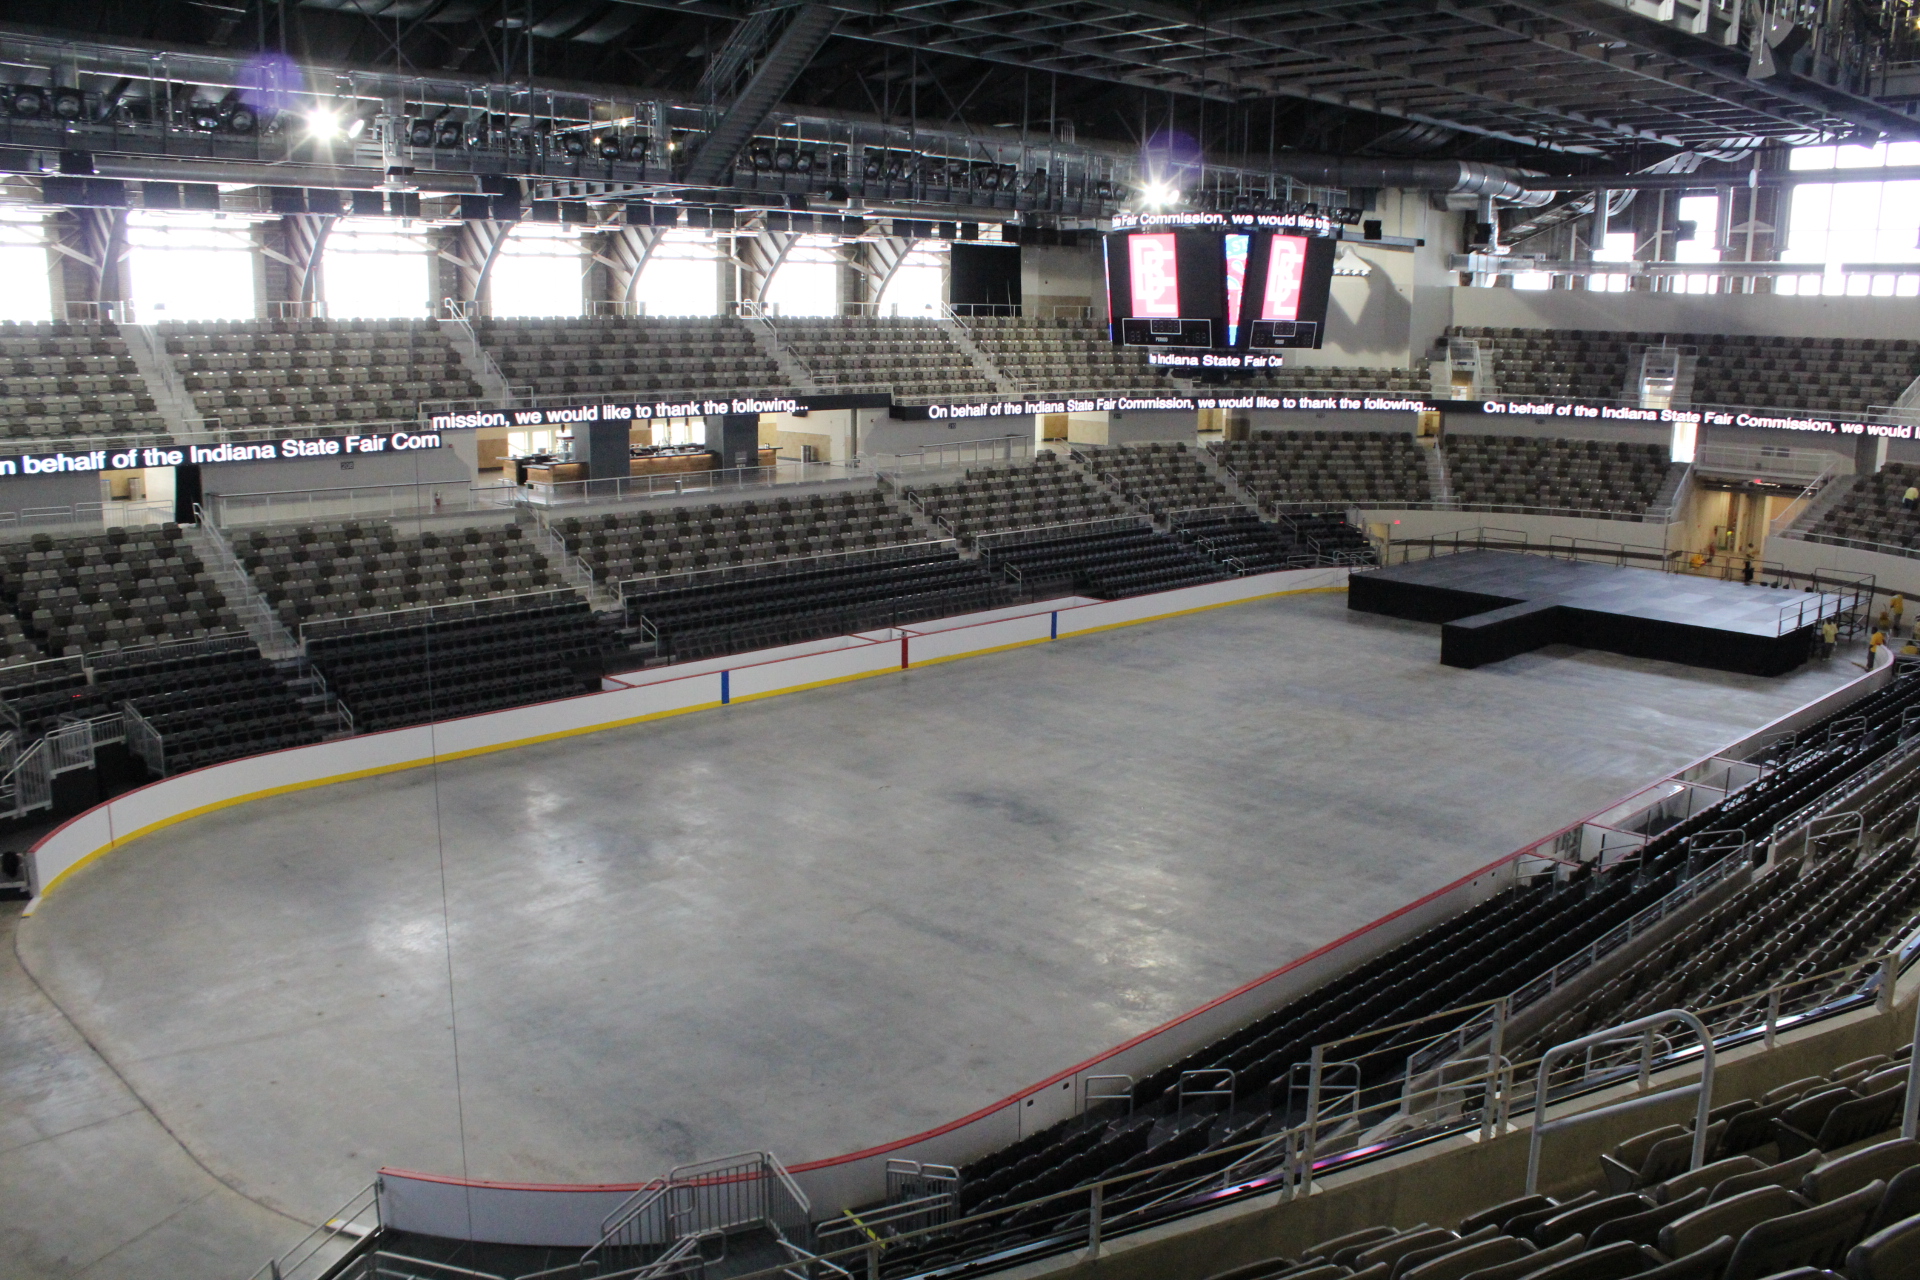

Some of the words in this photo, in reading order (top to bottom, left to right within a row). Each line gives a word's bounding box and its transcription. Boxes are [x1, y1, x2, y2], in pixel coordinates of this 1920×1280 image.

[1122, 214, 1139, 226] Fair
[1140, 212, 1227, 225] Commission,
[1231, 214, 1253, 224] we
[1257, 213, 1296, 226] would
[1298, 215, 1314, 228] like
[1315, 218, 1322, 229] to
[1158, 354, 1199, 365] Indiana
[1203, 355, 1240, 366] State
[1244, 355, 1267, 367] Fair
[432, 411, 510, 429] mission,
[515, 412, 542, 425] we
[546, 405, 598, 423] would
[603, 403, 632, 420] like
[635, 403, 651, 419] to
[655, 400, 700, 417] thank
[704, 398, 729, 415] the
[732, 397, 809, 413] following...
[929, 405, 948, 419] On
[951, 402, 988, 417] behalf
[990, 402, 1003, 415] of
[1004, 402, 1022, 415] the
[1025, 400, 1064, 414] Indiana
[1067, 399, 1094, 412] State
[1097, 398, 1116, 410] Fair
[1118, 397, 1194, 410] Commission,
[1198, 399, 1216, 409] we
[1219, 397, 1254, 409] would
[1257, 397, 1280, 409] like
[1283, 398, 1297, 409] to
[1299, 397, 1337, 409] thank
[1340, 397, 1361, 409] the
[1364, 397, 1437, 412] following...
[1484, 401, 1506, 414] On
[1509, 401, 1554, 415] behalf
[1556, 404, 1572, 417] of
[1574, 405, 1598, 418] the
[1602, 406, 1657, 421] Indiana
[1660, 409, 1700, 423] State
[1704, 412, 1732, 425] Fair
[1736, 414, 1836, 433] Commission,
[1841, 423, 1864, 434] we
[1867, 425, 1912, 438] would
[22, 454, 105, 475] behalf
[112, 449, 140, 468] of
[144, 446, 183, 466] the
[190, 443, 276, 463] Indiana
[281, 438, 340, 457] State
[346, 435, 387, 453] Fair
[391, 432, 440, 450] Com
